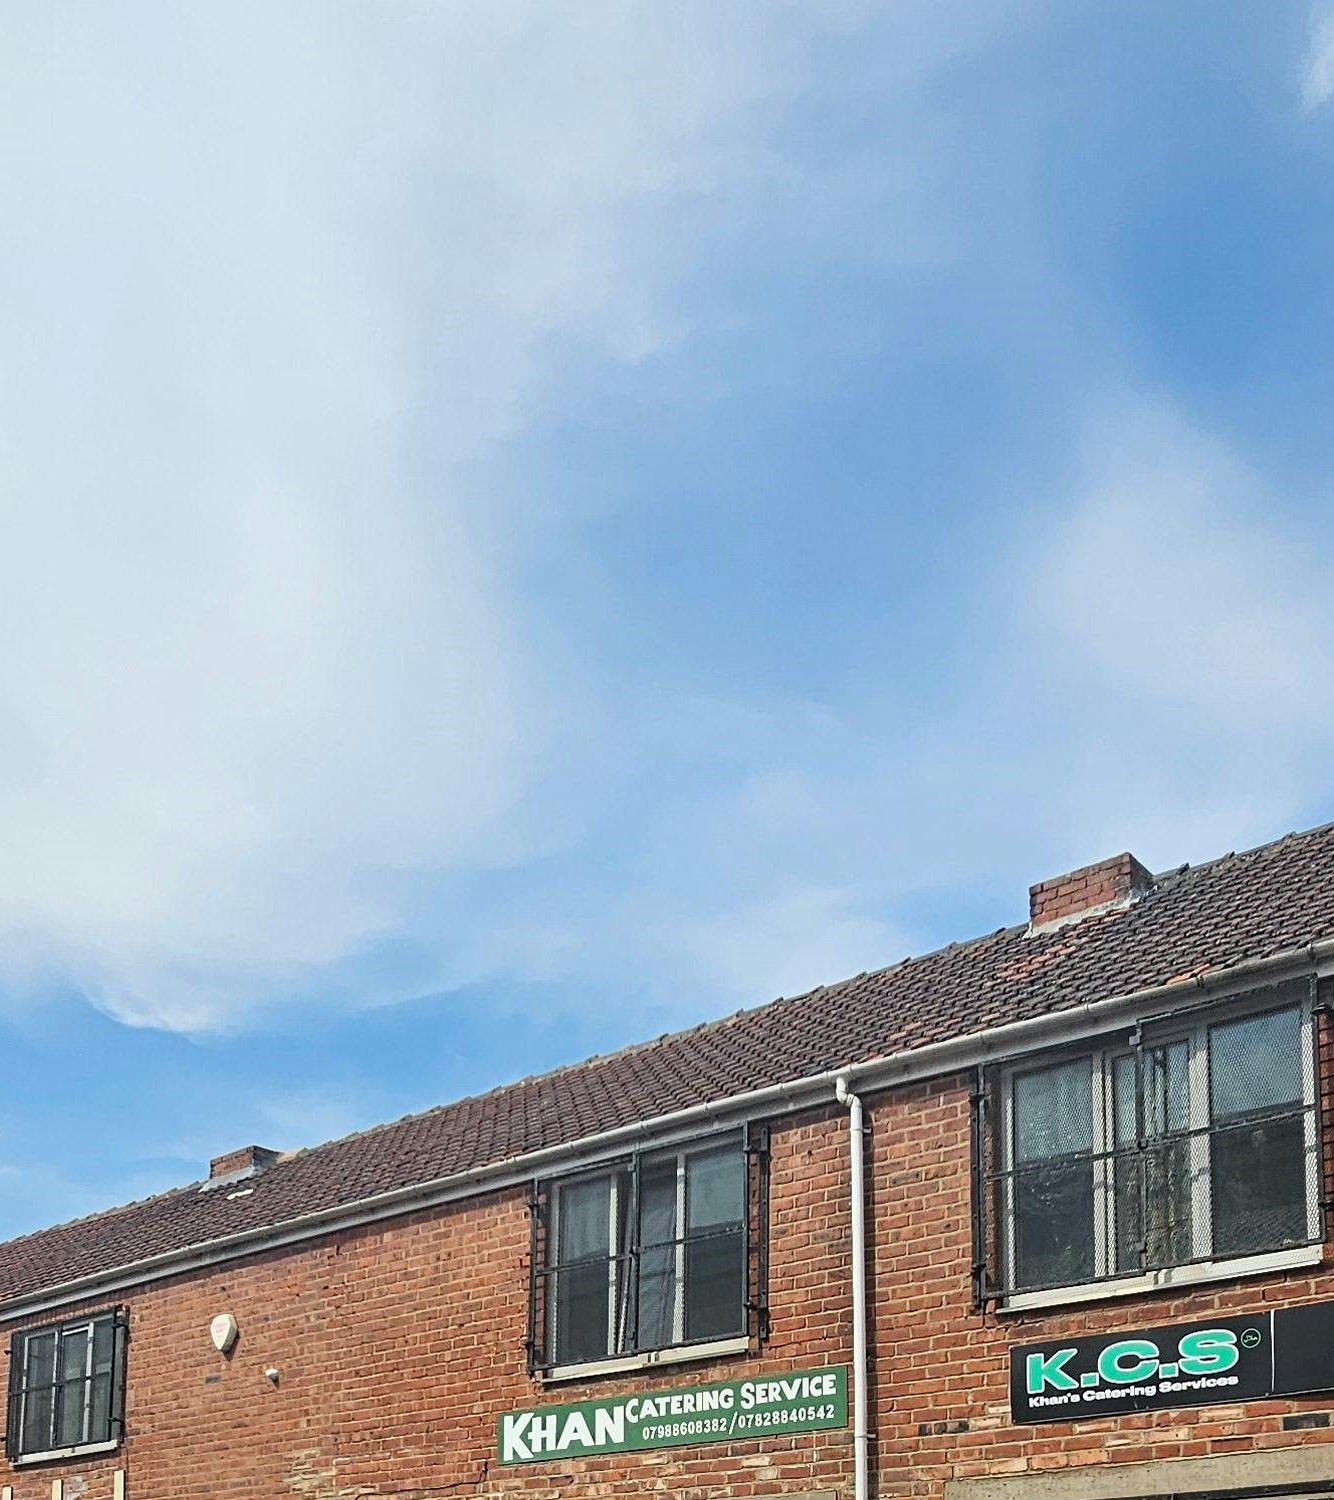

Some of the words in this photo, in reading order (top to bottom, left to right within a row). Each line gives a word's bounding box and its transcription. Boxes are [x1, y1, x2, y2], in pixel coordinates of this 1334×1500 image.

[1026, 1329, 1240, 1394] K.C.S
[1028, 1391, 1081, 1408] Khan's
[1083, 1385, 1156, 1402] Catering
[1159, 1376, 1239, 1393] Services
[503, 1405, 625, 1462] KHAN
[626, 1388, 734, 1423] CATERING
[741, 1375, 836, 1409] SERVICE
